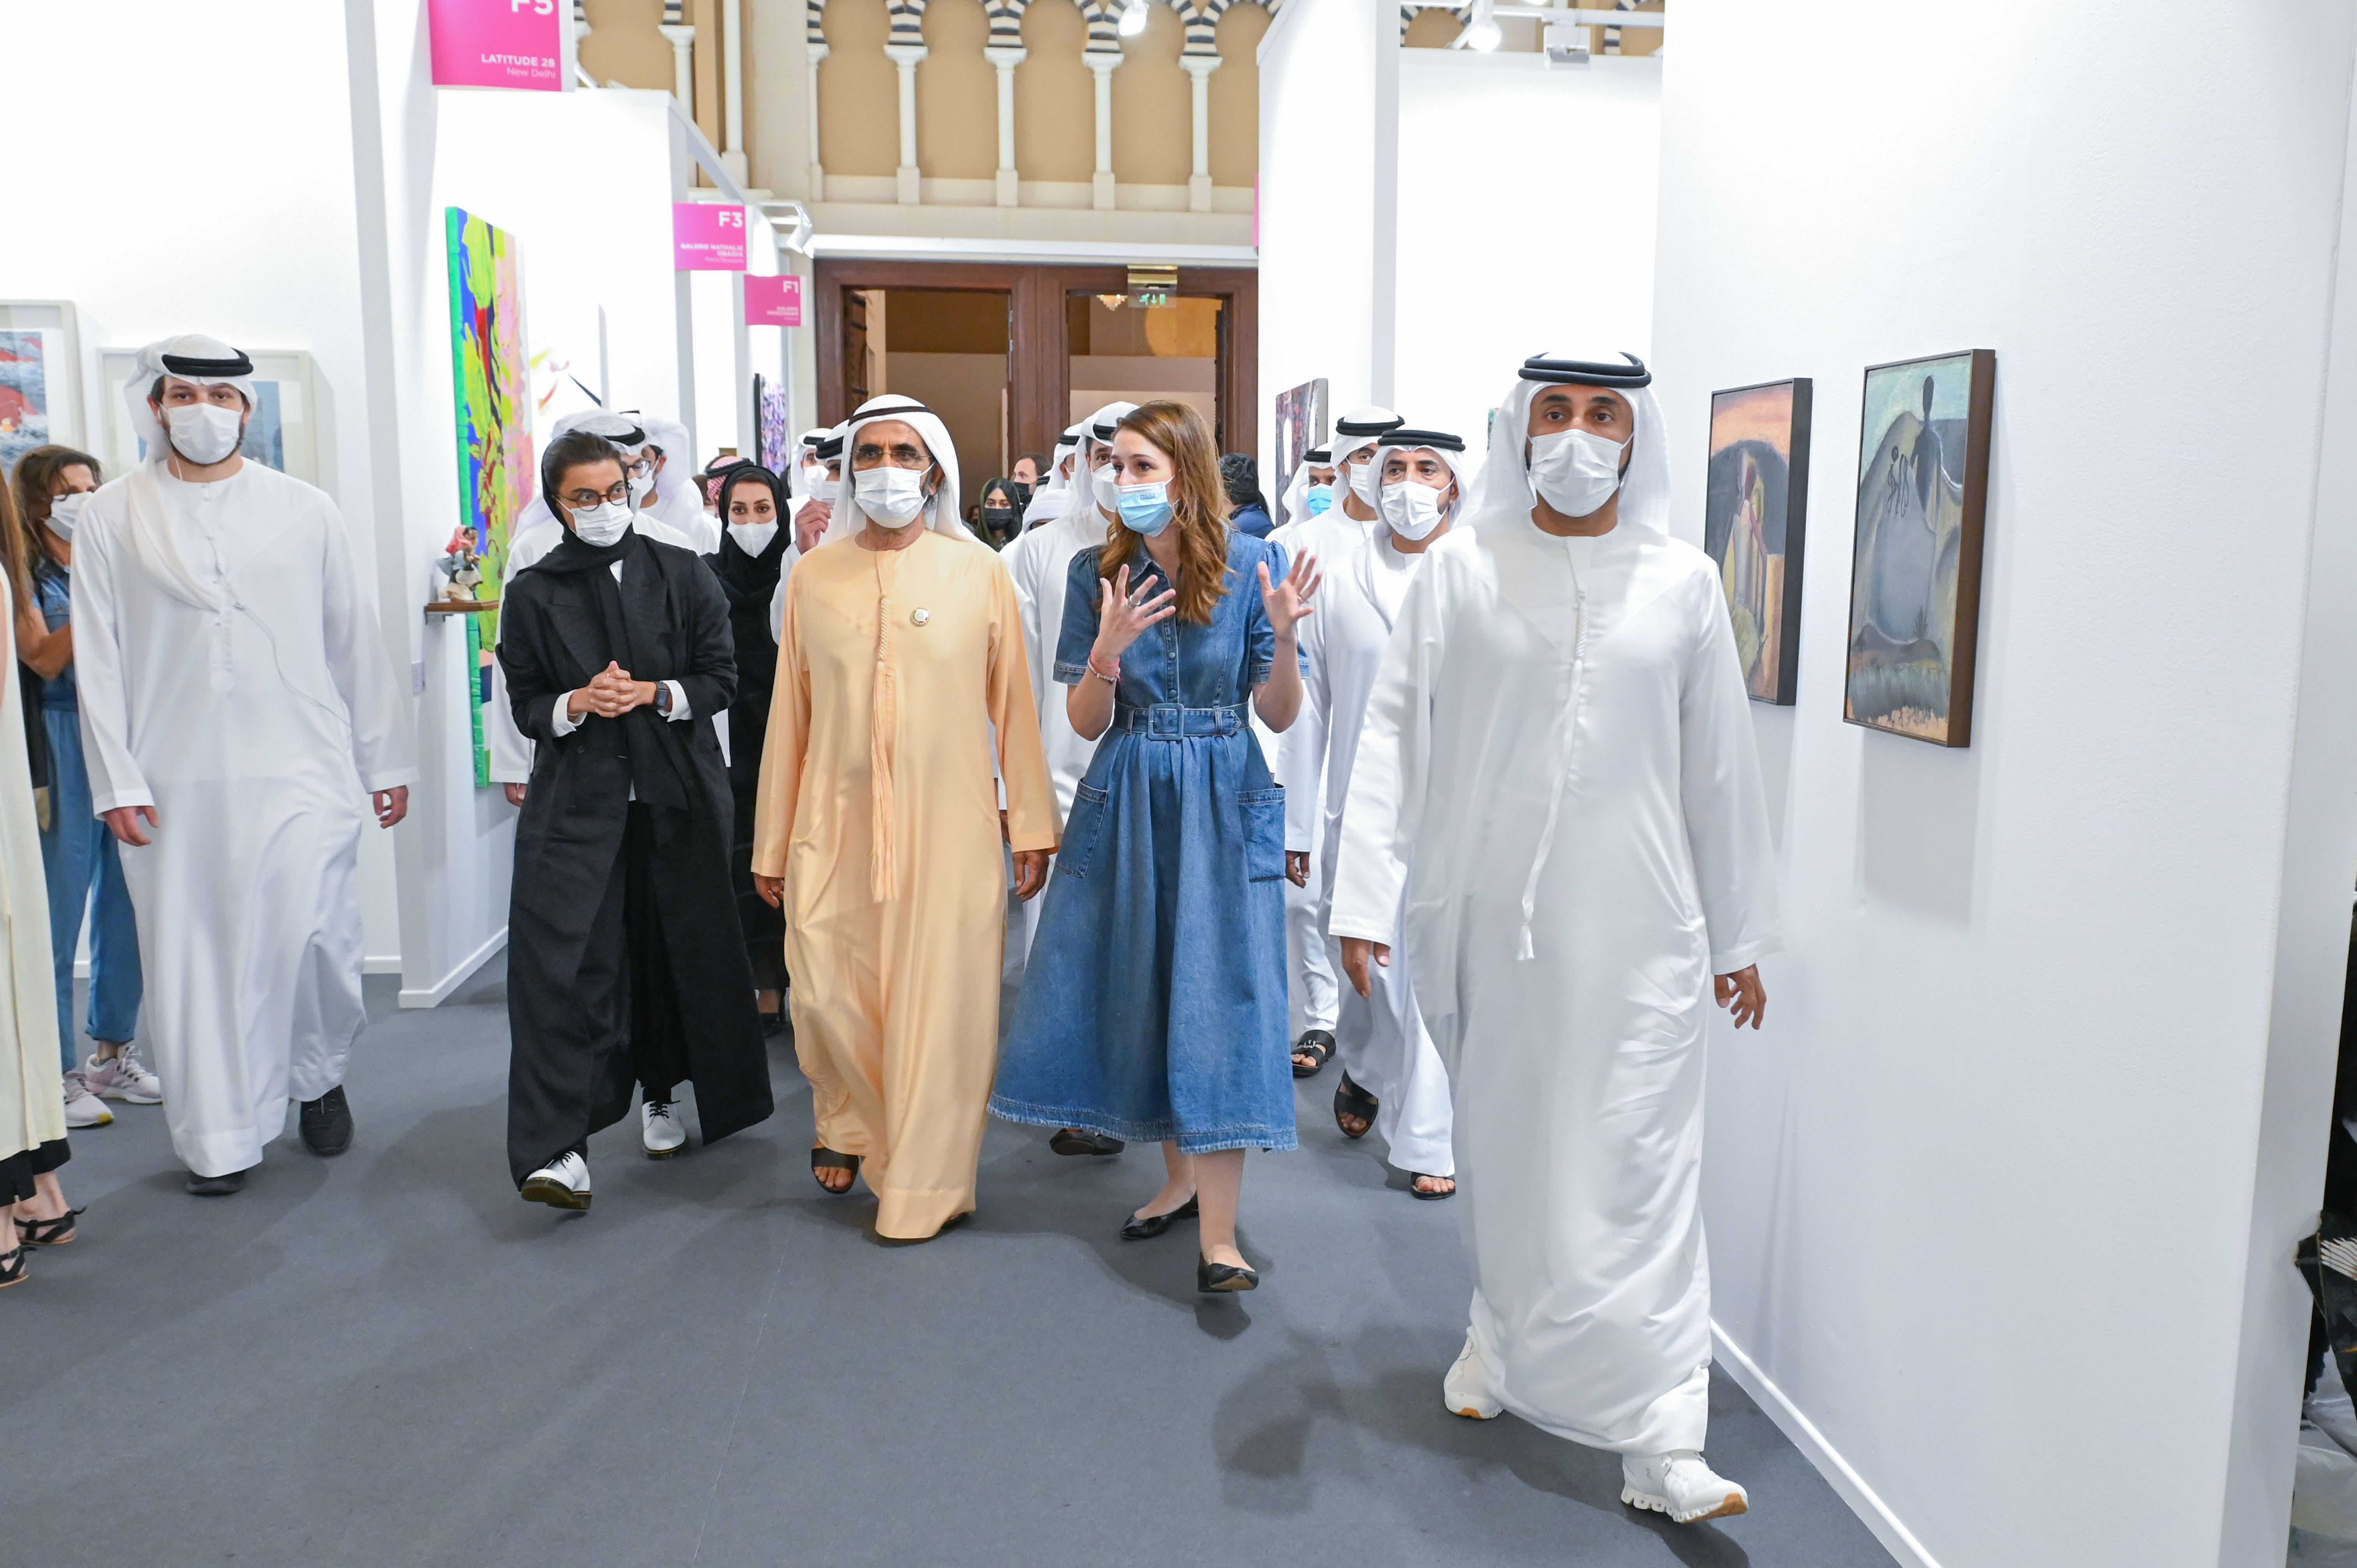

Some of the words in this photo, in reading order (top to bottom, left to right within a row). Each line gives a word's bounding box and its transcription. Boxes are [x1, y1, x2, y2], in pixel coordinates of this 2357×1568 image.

[481, 53, 538, 66] LATITUDE
[541, 58, 555, 67] 28
[507, 67, 528, 76] New
[531, 68, 555, 78] Delhi
[719, 211, 743, 228] F3
[783, 281, 799, 293] F1
